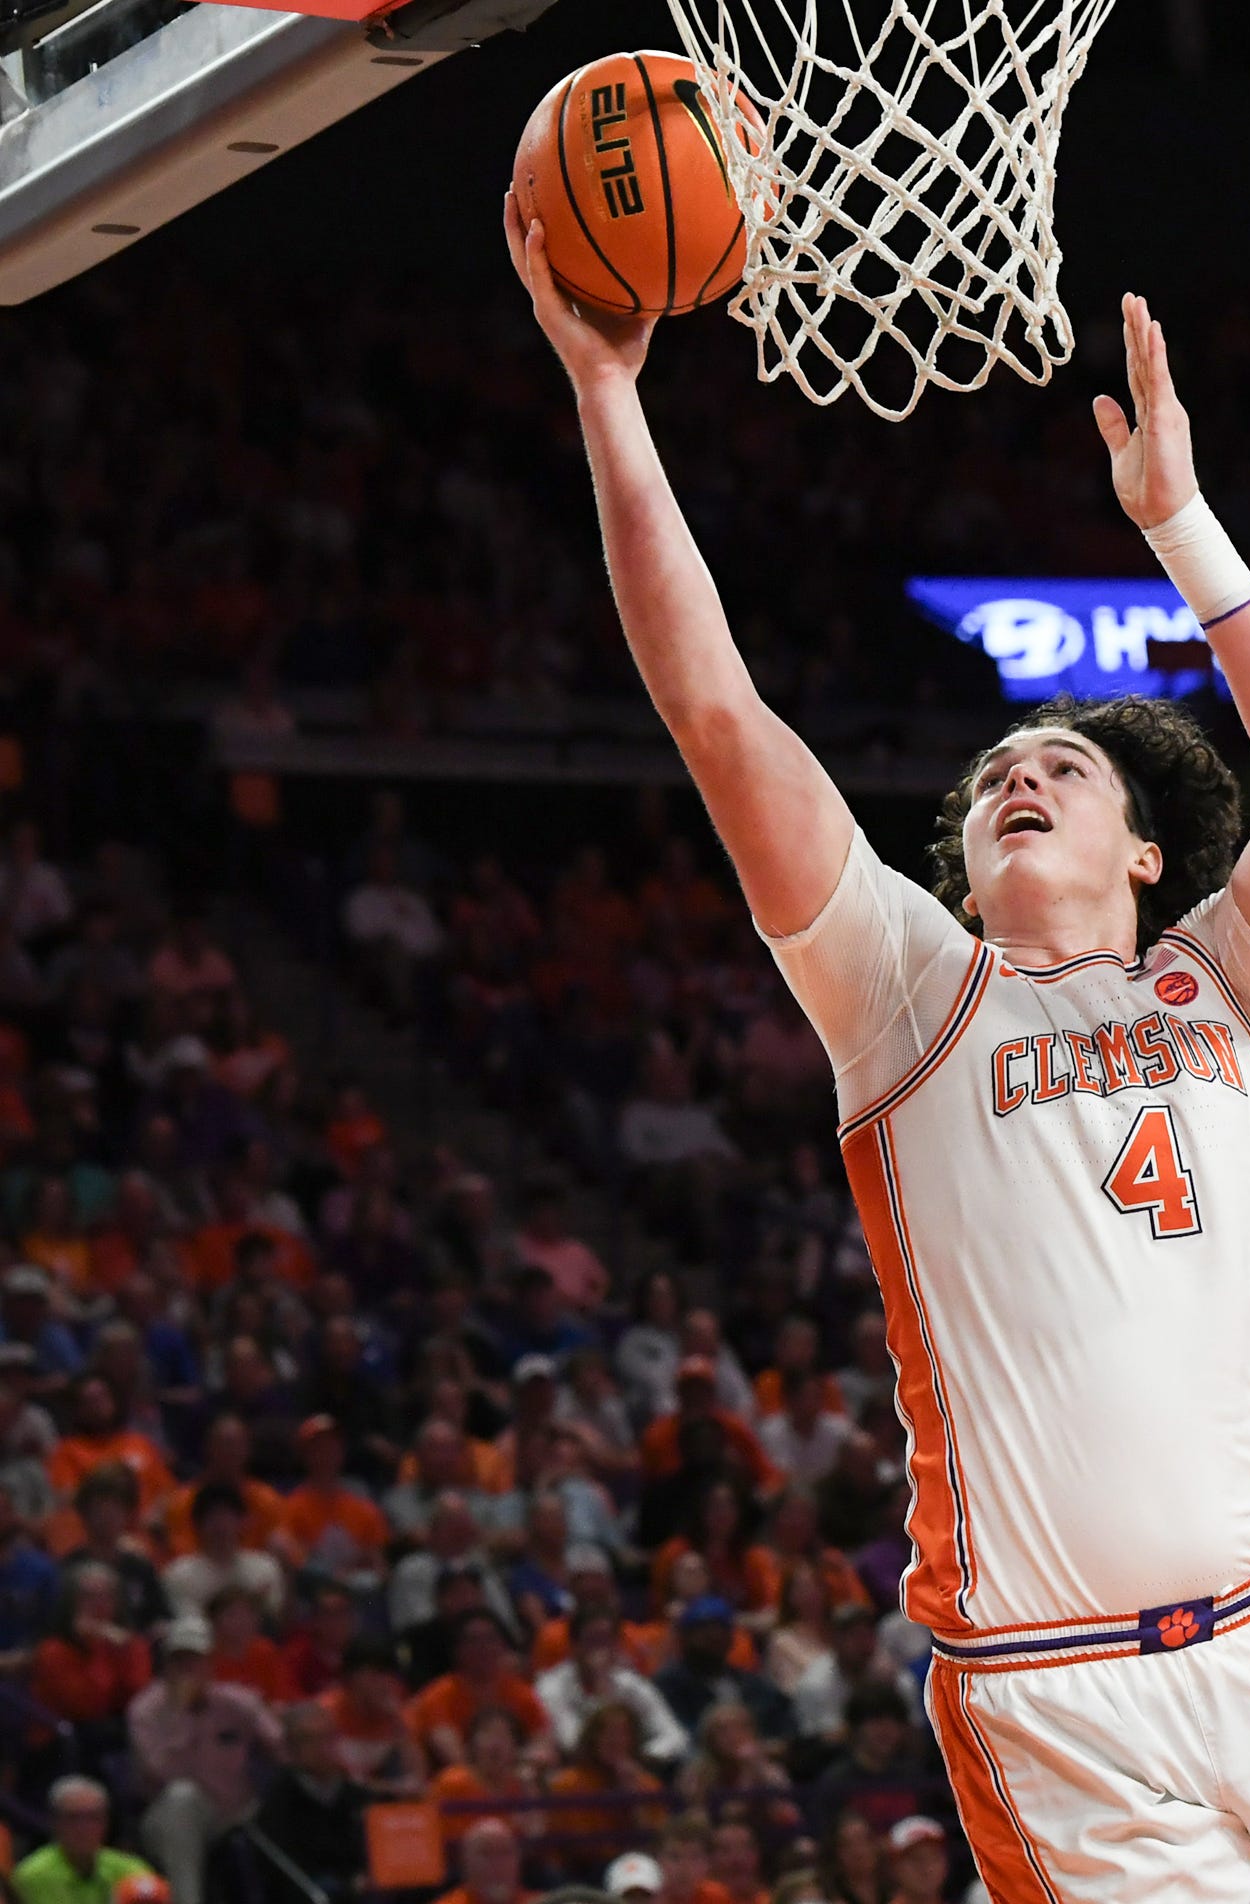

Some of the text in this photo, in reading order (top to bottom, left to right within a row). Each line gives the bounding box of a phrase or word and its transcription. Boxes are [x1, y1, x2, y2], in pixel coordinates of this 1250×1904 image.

[591, 82, 646, 219] ELITE
[991, 1011, 1248, 1118] CLEMSON
[1100, 1105, 1203, 1240] 4
